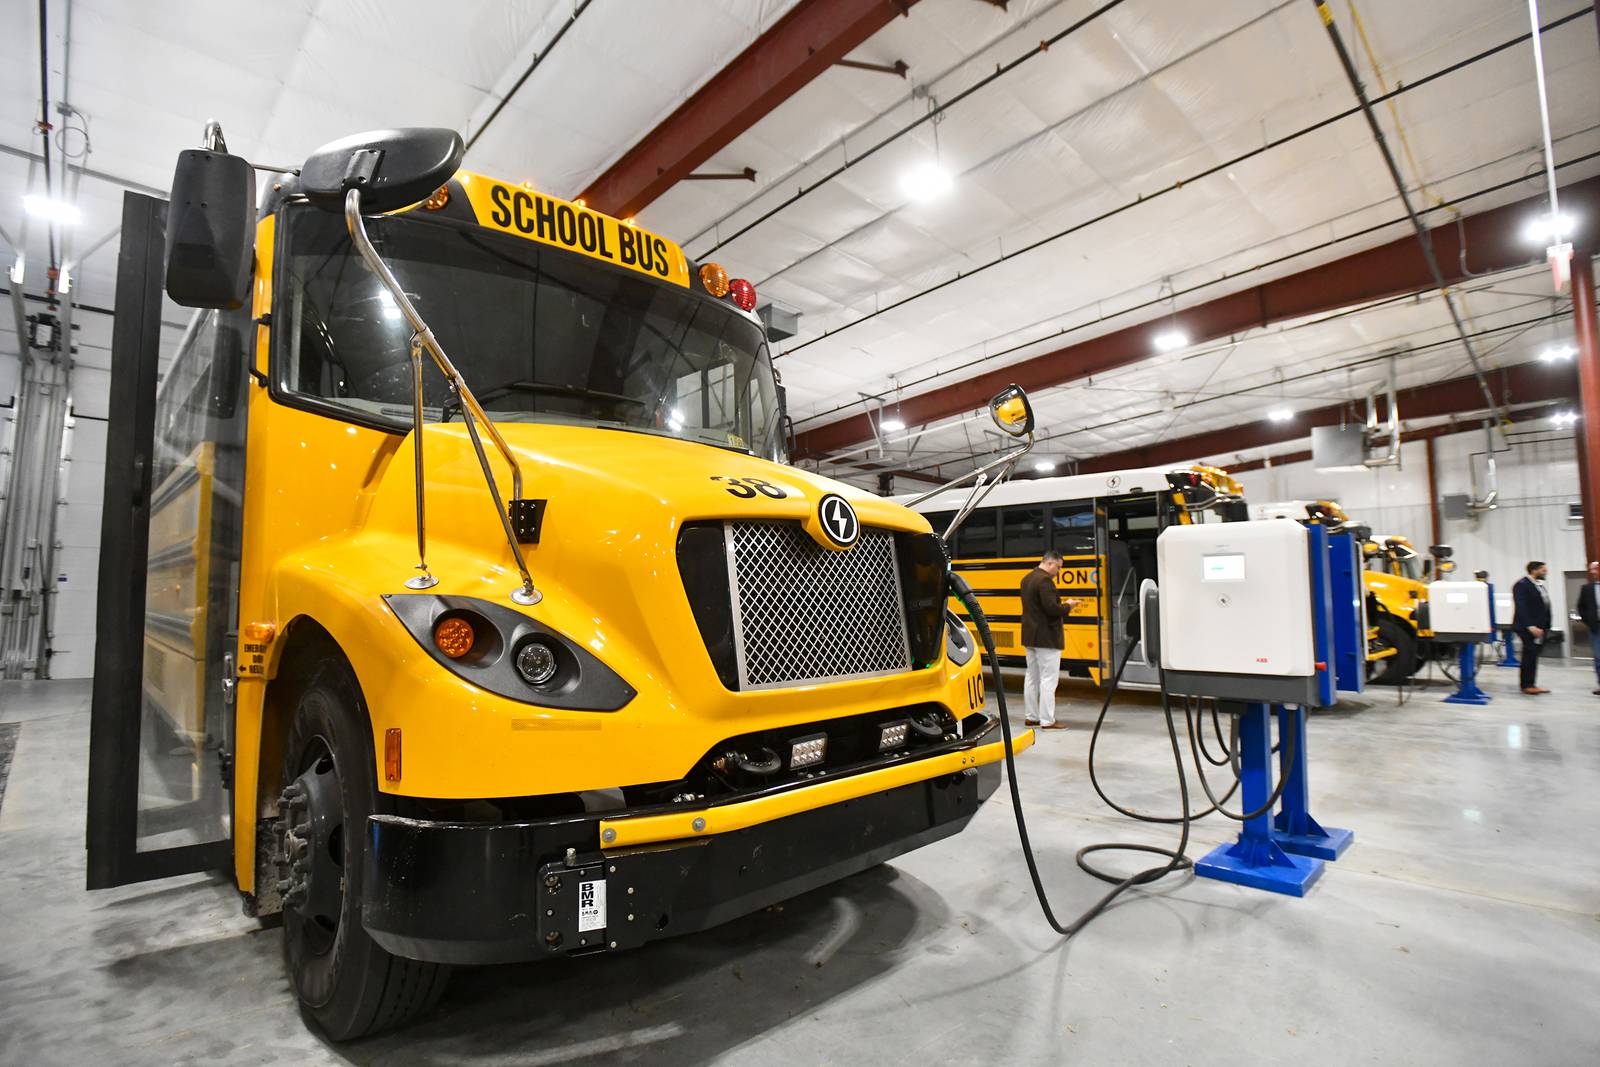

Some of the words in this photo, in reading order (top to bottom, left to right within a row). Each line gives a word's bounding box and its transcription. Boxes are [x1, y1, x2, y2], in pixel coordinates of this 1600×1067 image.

[491, 185, 613, 259] SCHOOL
[618, 223, 669, 277] BUS
[710, 475, 788, 499] 38
[581, 883, 594, 908] BMR
